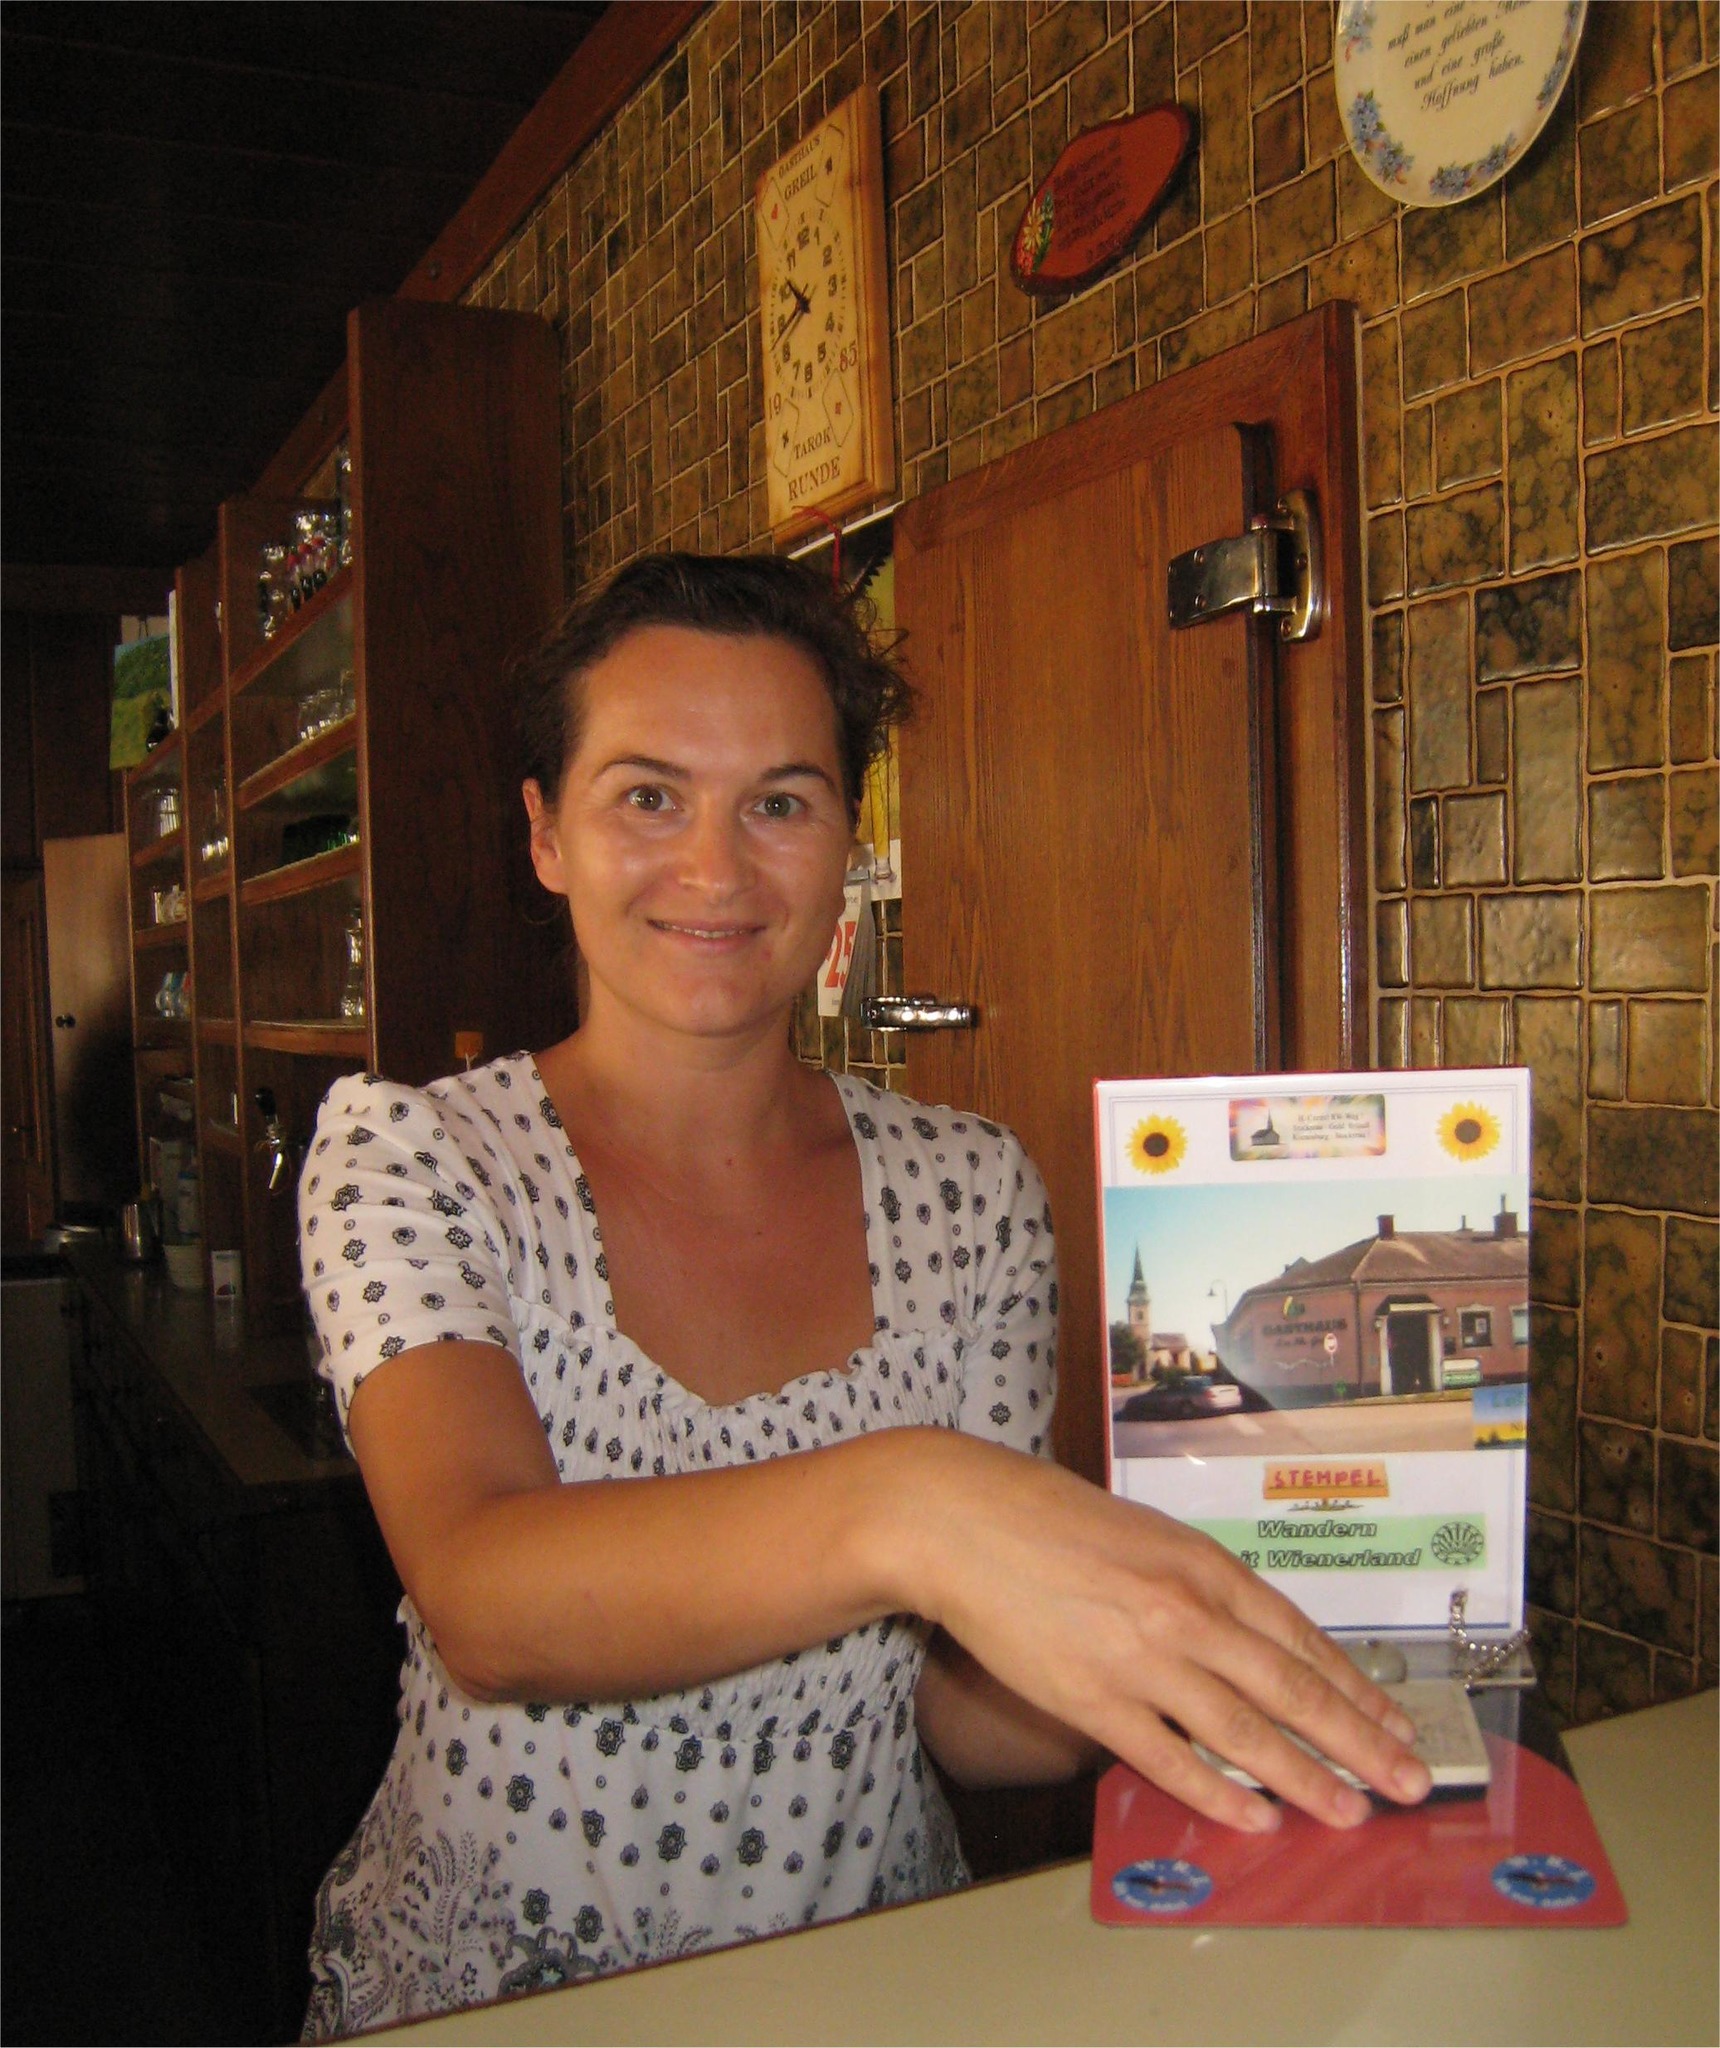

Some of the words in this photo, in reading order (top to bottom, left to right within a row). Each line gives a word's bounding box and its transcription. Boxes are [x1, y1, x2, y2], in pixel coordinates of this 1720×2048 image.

[1415, 16, 1436, 35] man
[1404, 46, 1432, 68] einen
[1414, 62, 1436, 90] und
[1441, 56, 1463, 76] eine
[1421, 75, 1480, 111] Hoffnung
[784, 163, 817, 200] GREIL
[823, 244, 832, 267] 2
[828, 273, 838, 297] 3
[825, 312, 835, 332] 4
[782, 341, 791, 363] 8
[818, 341, 827, 363] 5
[793, 358, 801, 380] 7
[793, 426, 831, 461] TAROK
[787, 456, 841, 501] RUNDE
[1273, 1468, 1382, 1489] STEMPEL
[1257, 1519, 1378, 1539] Wandern
[1241, 1549, 1260, 1569] it
[1267, 1548, 1422, 1569] Wienerland
